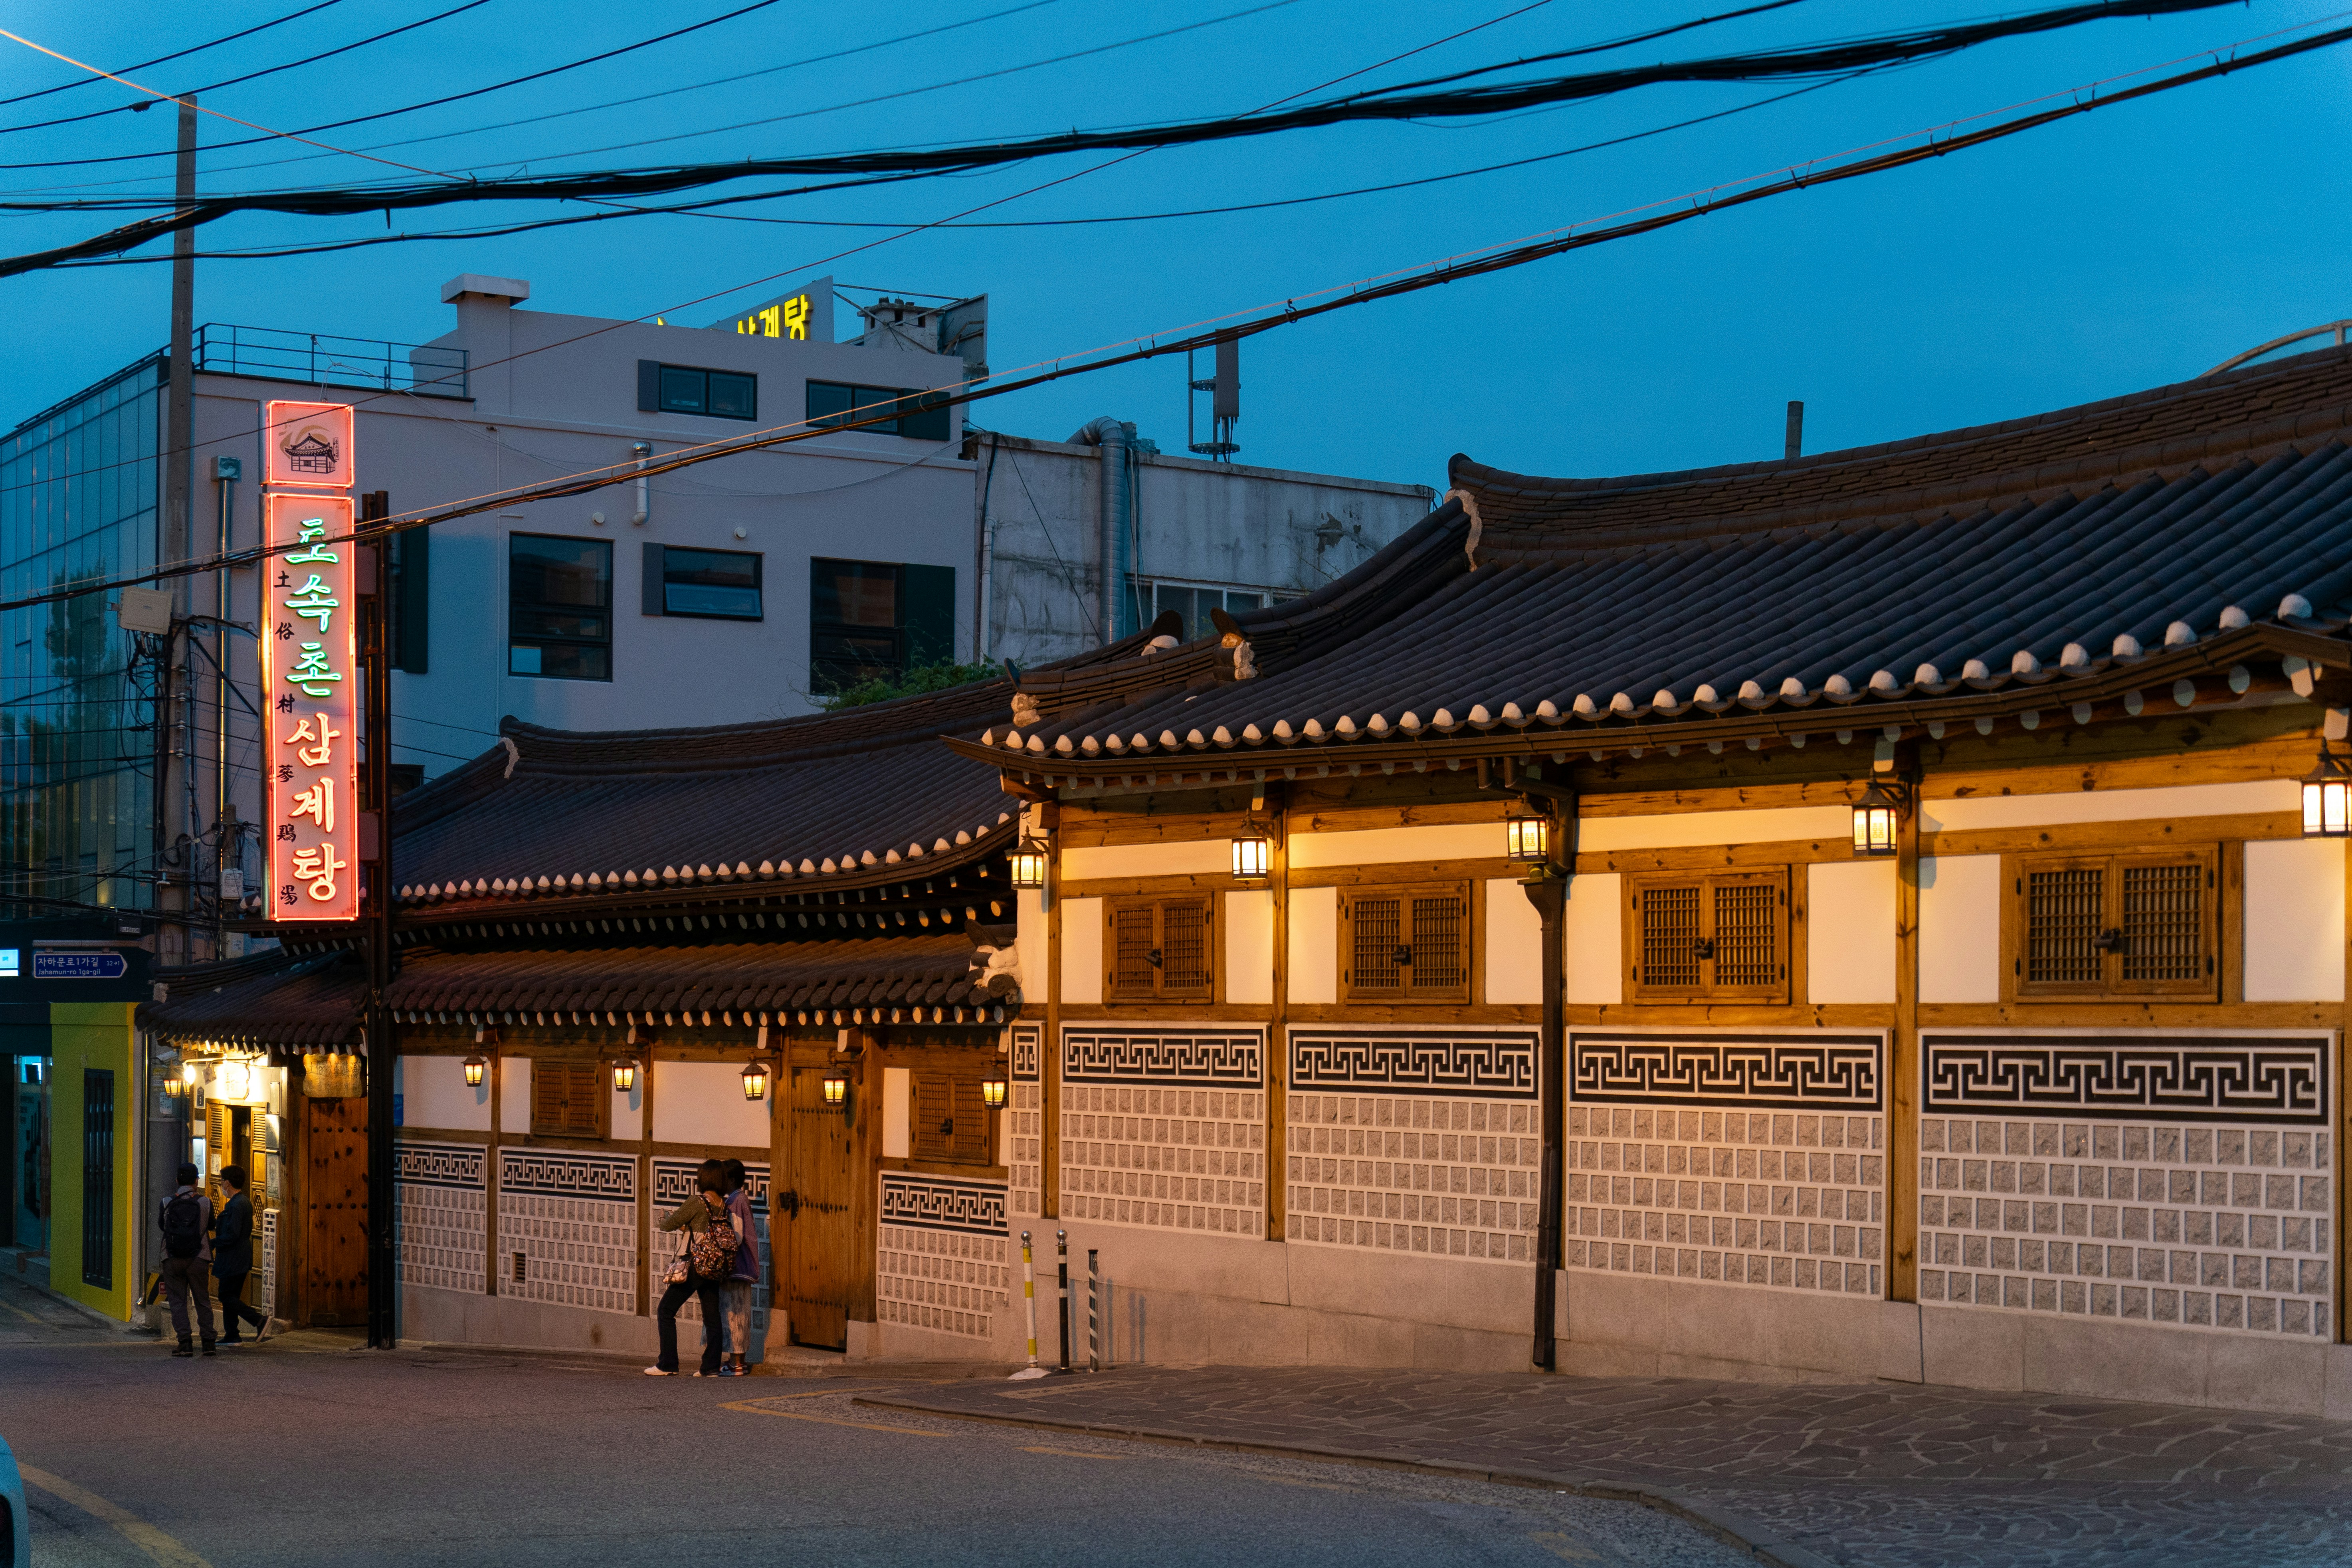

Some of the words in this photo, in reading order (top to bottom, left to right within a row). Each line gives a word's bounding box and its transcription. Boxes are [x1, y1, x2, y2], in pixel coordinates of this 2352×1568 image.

[284, 518, 343, 697] 토속촌
[284, 713, 346, 901] 삼계탕
[38, 957, 98, 967] 자하문로1가길
